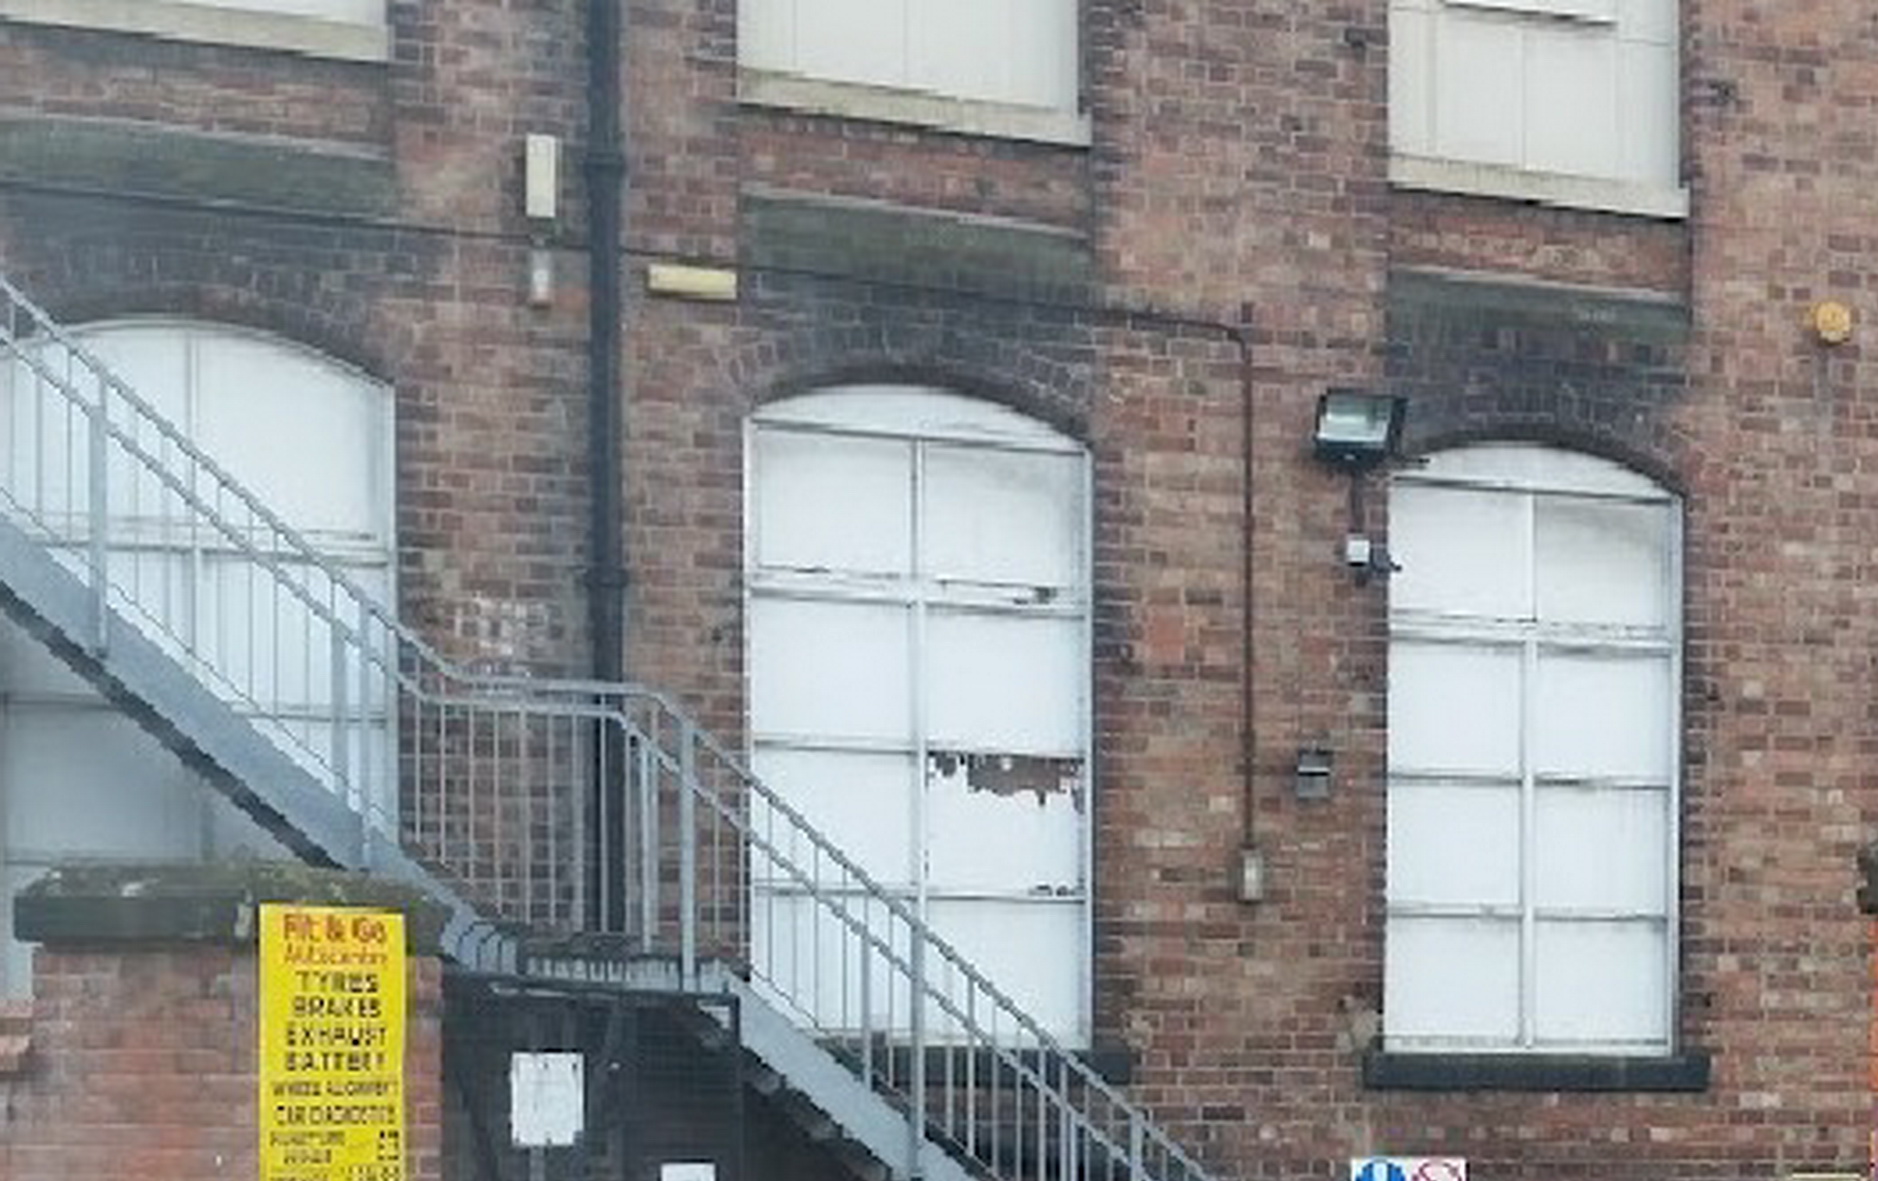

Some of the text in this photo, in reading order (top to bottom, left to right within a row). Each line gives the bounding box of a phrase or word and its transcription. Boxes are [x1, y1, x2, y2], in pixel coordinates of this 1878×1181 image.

[284, 914, 321, 943] Fit
[326, 914, 346, 942] &
[294, 971, 379, 993] TYRES
[293, 996, 382, 1018] BRAKES
[287, 1022, 387, 1046] EXHAUST
[286, 1052, 386, 1071] BATTERY
[270, 1080, 399, 1096] WHEEL ALIGNMENT
[275, 1105, 307, 1126] CAR
